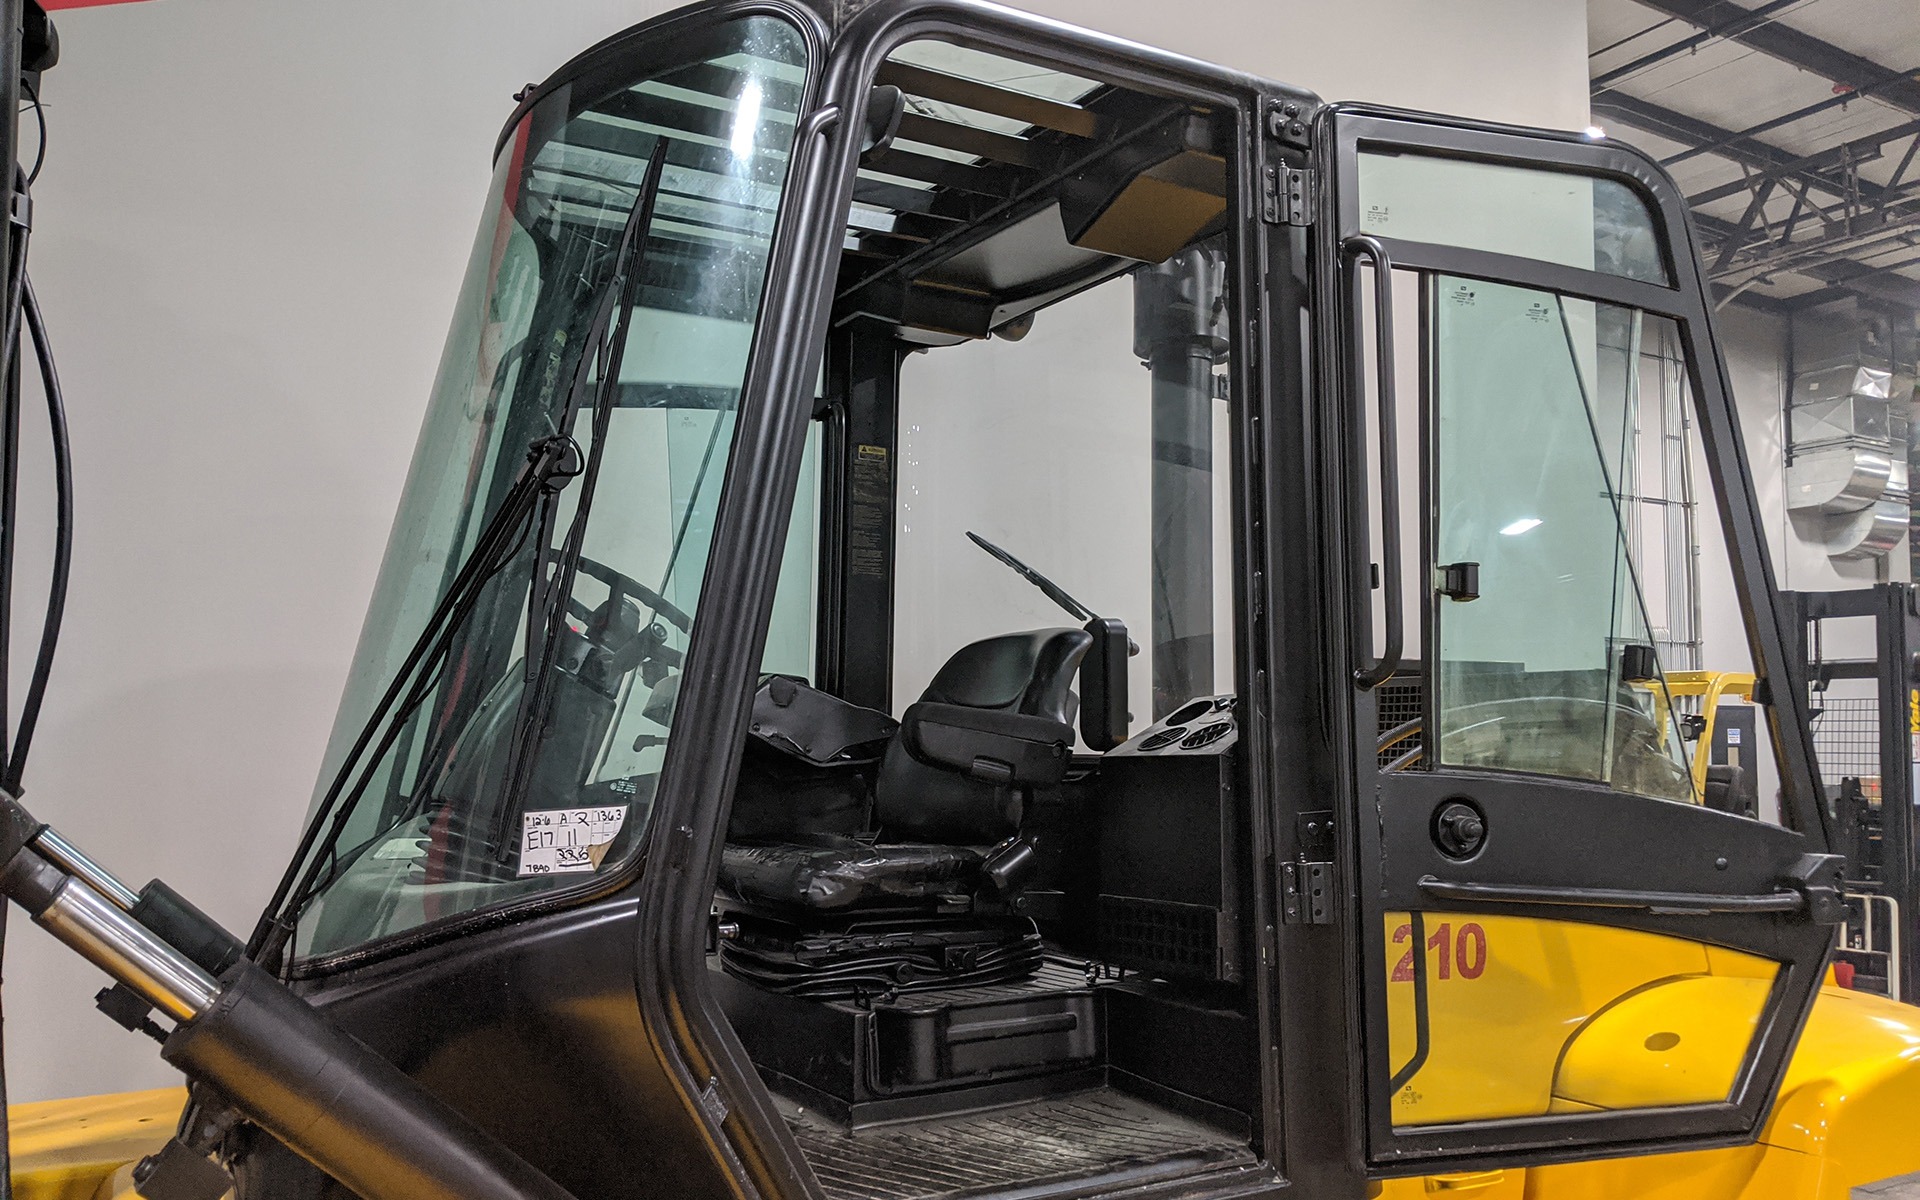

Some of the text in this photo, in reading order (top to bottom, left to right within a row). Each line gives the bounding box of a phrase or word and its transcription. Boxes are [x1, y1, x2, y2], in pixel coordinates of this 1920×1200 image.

[560, 813, 568, 824] A
[527, 830, 553, 850] E17
[1391, 923, 1487, 982] 210
